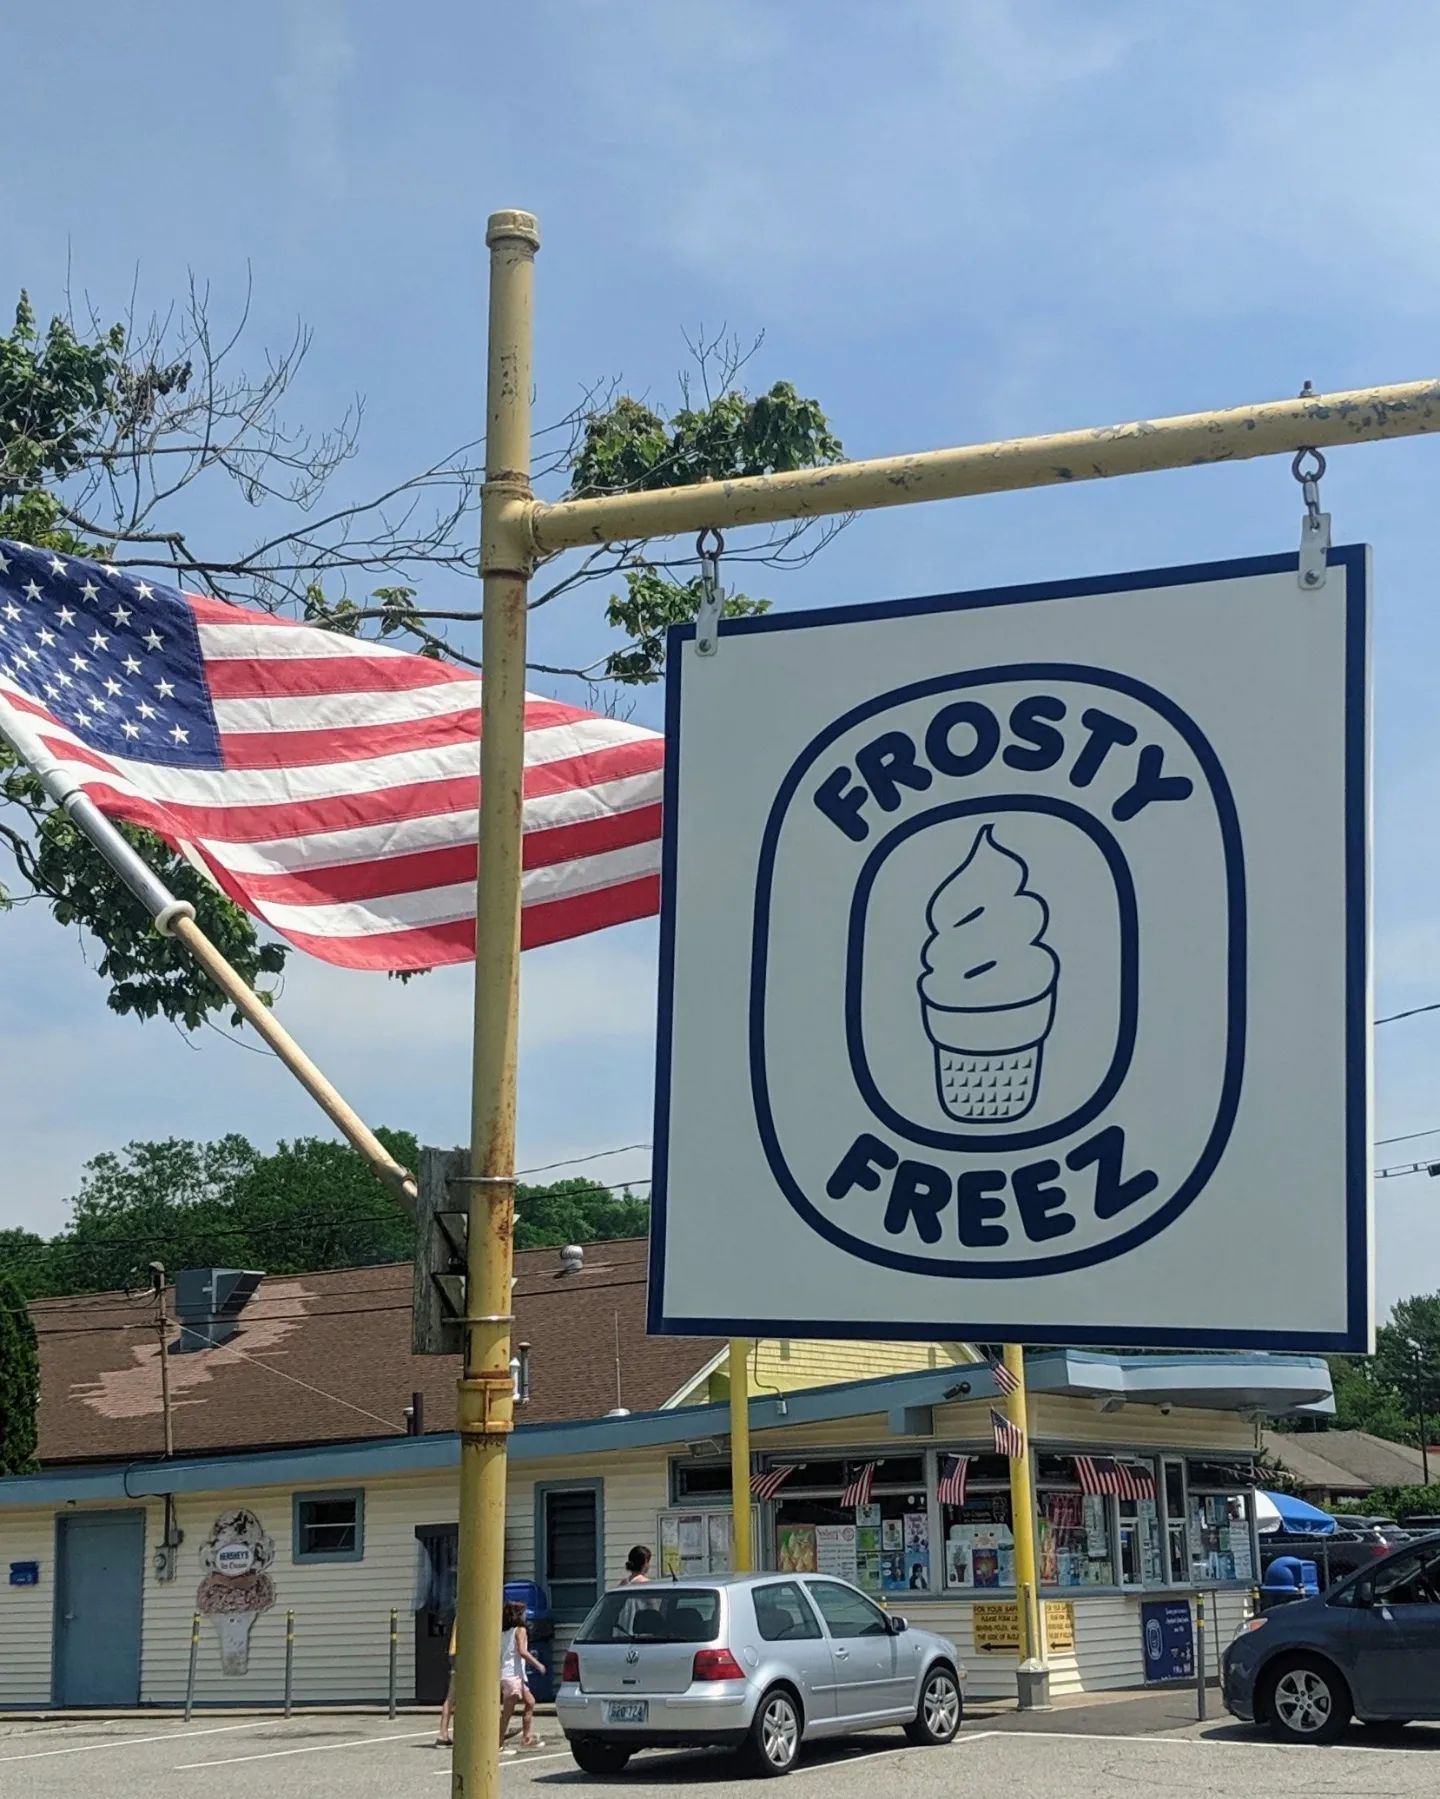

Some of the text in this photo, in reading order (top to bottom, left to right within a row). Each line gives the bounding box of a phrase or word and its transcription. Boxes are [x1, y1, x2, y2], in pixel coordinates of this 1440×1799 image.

[813, 695, 1193, 842] FROSTY
[826, 1125, 1159, 1248] FREEZ
[220, 1551, 249, 1560] HERSHEY'S
